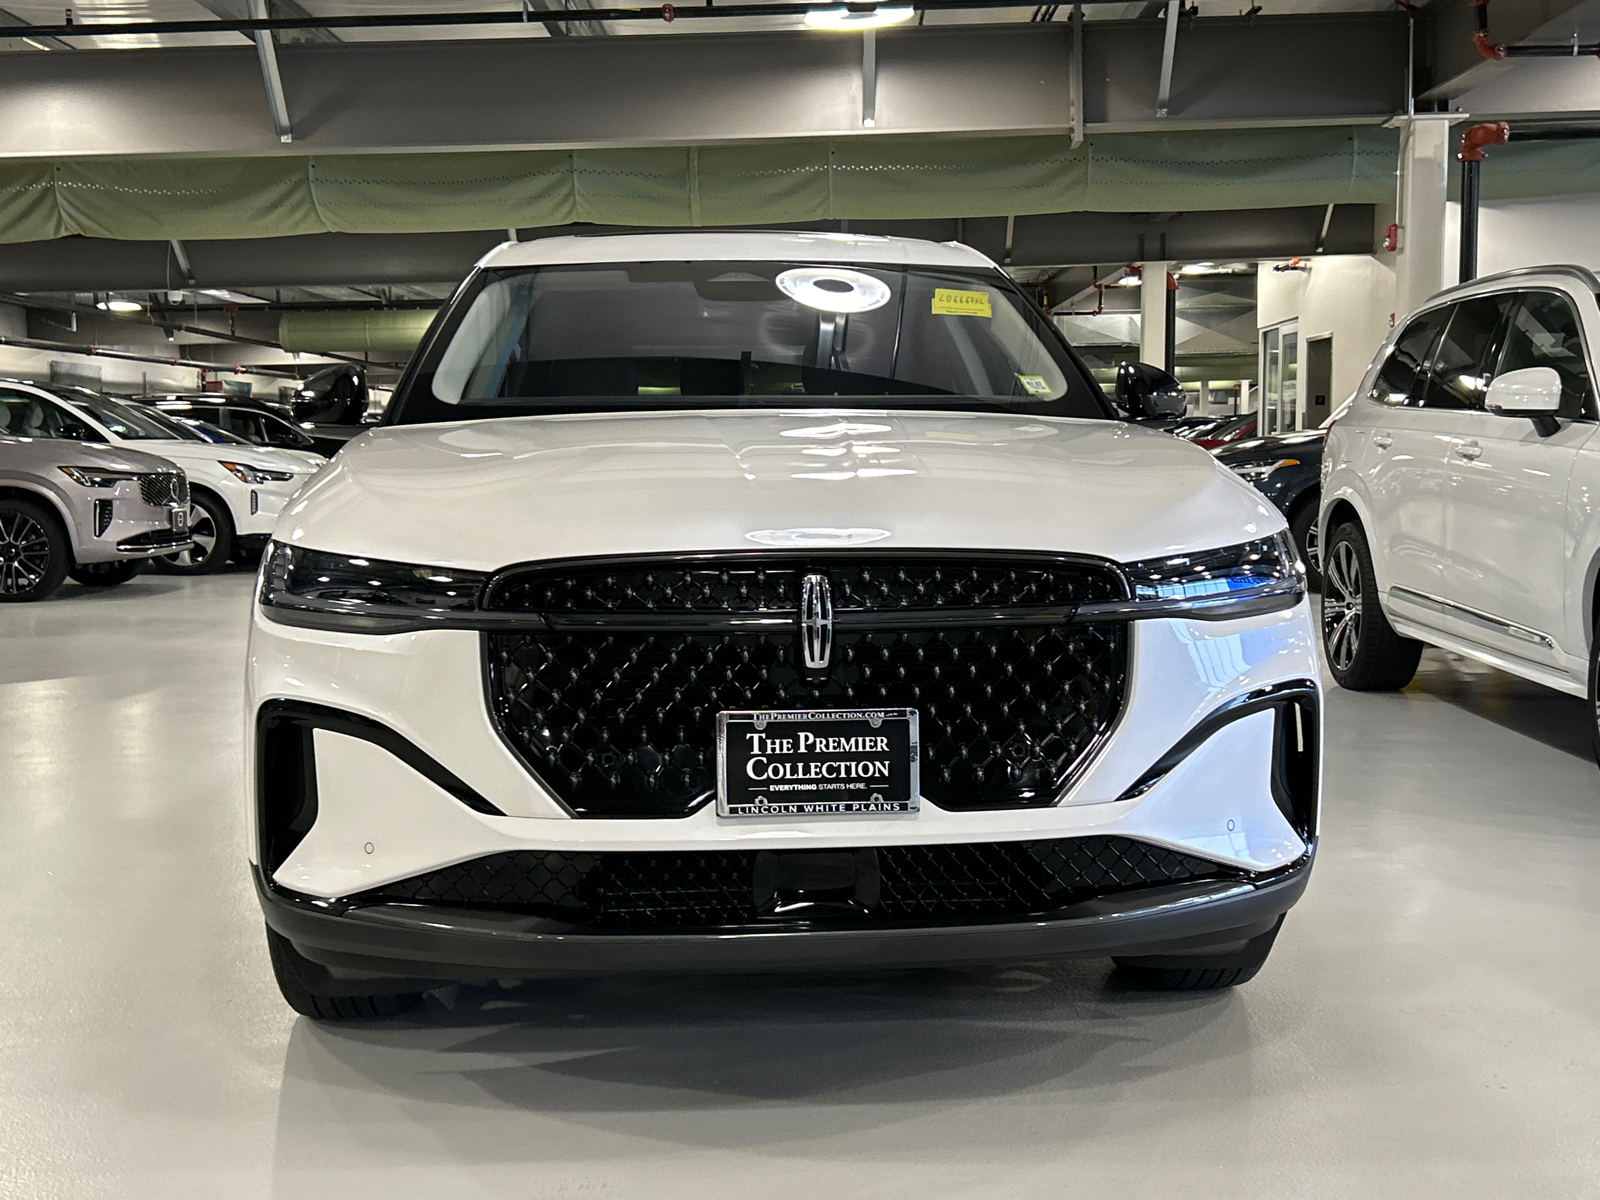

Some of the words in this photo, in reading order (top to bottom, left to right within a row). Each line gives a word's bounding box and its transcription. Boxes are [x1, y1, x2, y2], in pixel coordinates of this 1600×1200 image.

[746, 732, 794, 755] THE
[797, 731, 890, 753] PREMIER
[746, 756, 890, 780] COLLECTION
[769, 784, 818, 792] EVERYTHING
[738, 805, 798, 815] LINCOLN
[803, 803, 846, 813] WHITE
[852, 802, 901, 812] PLAINS
